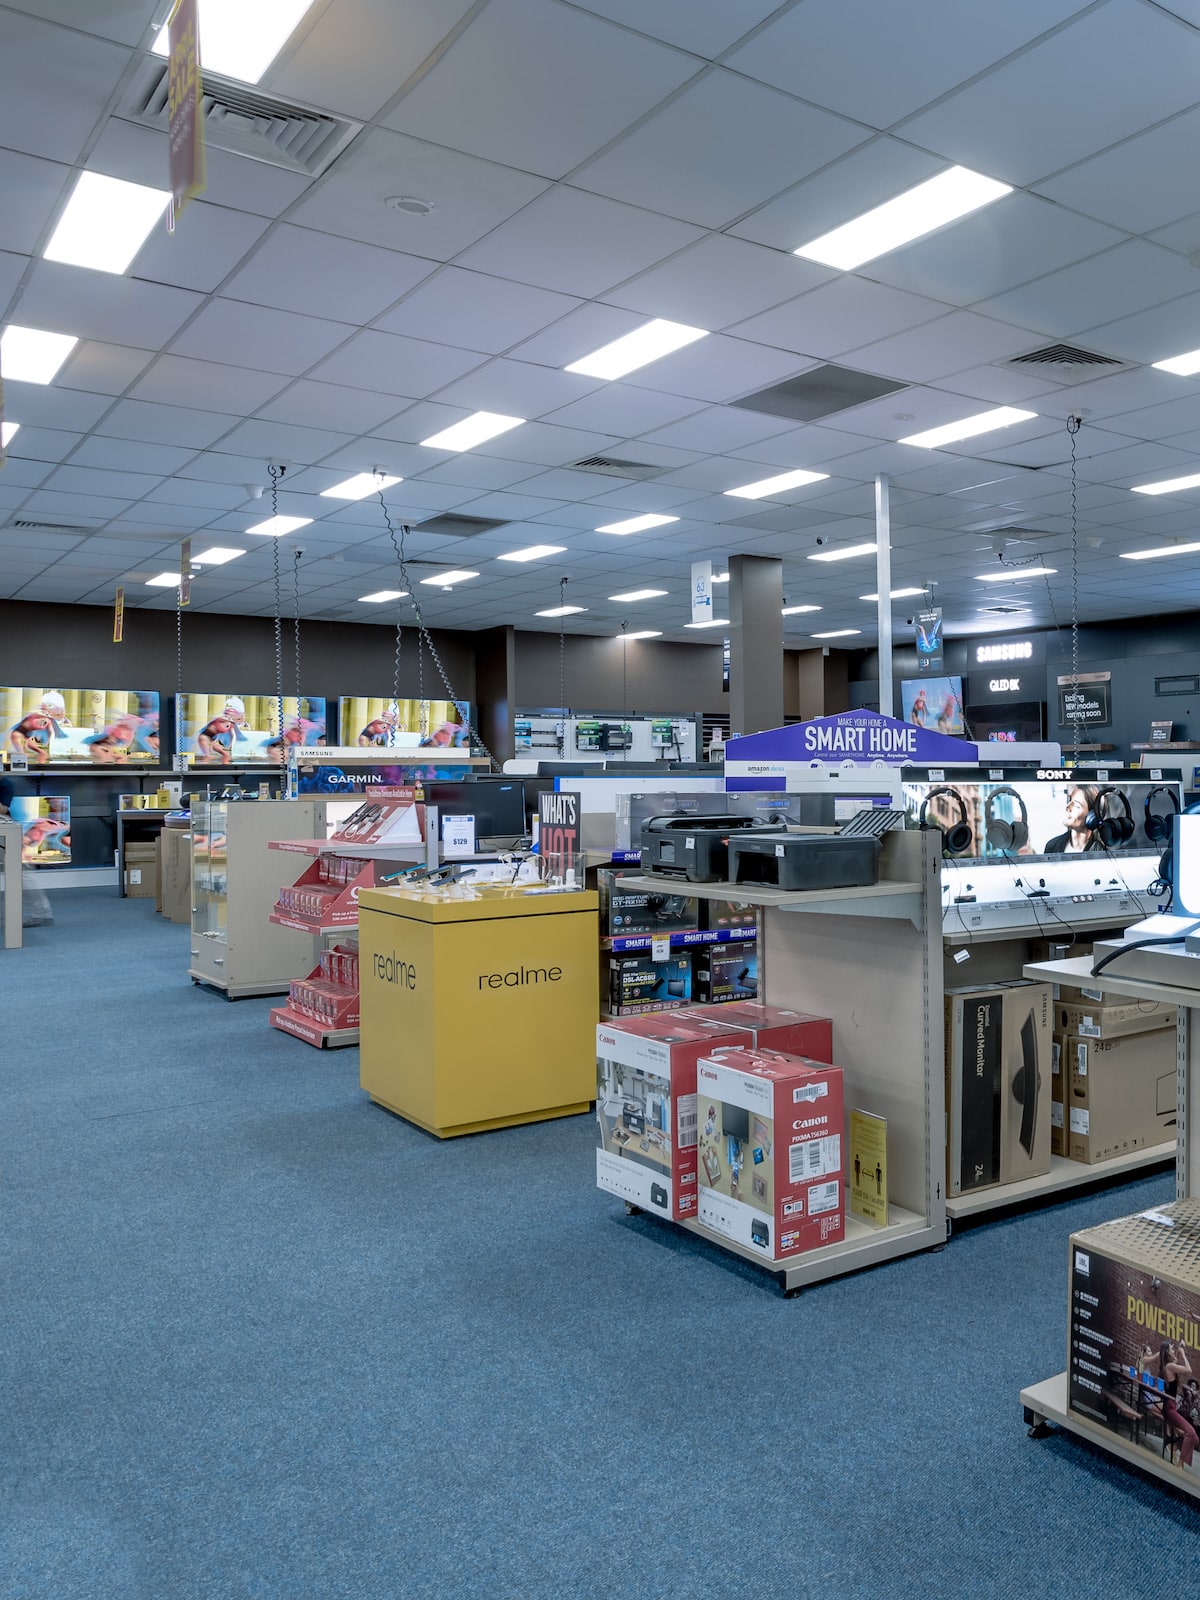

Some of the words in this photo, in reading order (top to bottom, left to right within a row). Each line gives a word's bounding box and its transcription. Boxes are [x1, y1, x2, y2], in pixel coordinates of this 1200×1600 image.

[976, 641, 1033, 663] SAMSUNG
[989, 679, 1008, 692] QLED
[1009, 678, 1020, 691] 8K
[1064, 694, 1085, 704] Exciting
[1077, 702, 1100, 710] models
[1066, 710, 1086, 720] coming
[1086, 709, 1102, 718] soon
[837, 718, 853, 726] MAKE
[854, 718, 866, 727] YOUR
[867, 718, 882, 727] HOME
[882, 719, 888, 727] A
[804, 725, 865, 751] SMART
[869, 727, 917, 752] HOME
[327, 774, 383, 784] GARMIN
[1036, 769, 1073, 780] SONY
[541, 794, 577, 826] WHAT'S
[541, 827, 577, 880] HOT
[624, 852, 641, 861] SMAR
[684, 933, 702, 942] SMART
[702, 932, 718, 941] HOME
[625, 940, 645, 948] SMART
[372, 949, 417, 990] realme
[478, 965, 563, 990] realme
[976, 1004, 986, 1040] Curved
[598, 1033, 616, 1046] Canon
[1094, 1043, 1104, 1053] 24
[976, 1040, 984, 1078] Monitor
[700, 1068, 718, 1081] Canon
[792, 1115, 828, 1130] Canon
[791, 1133, 811, 1143] PIXMA
[810, 1129, 829, 1140] TS6360
[974, 1163, 984, 1176] 24
